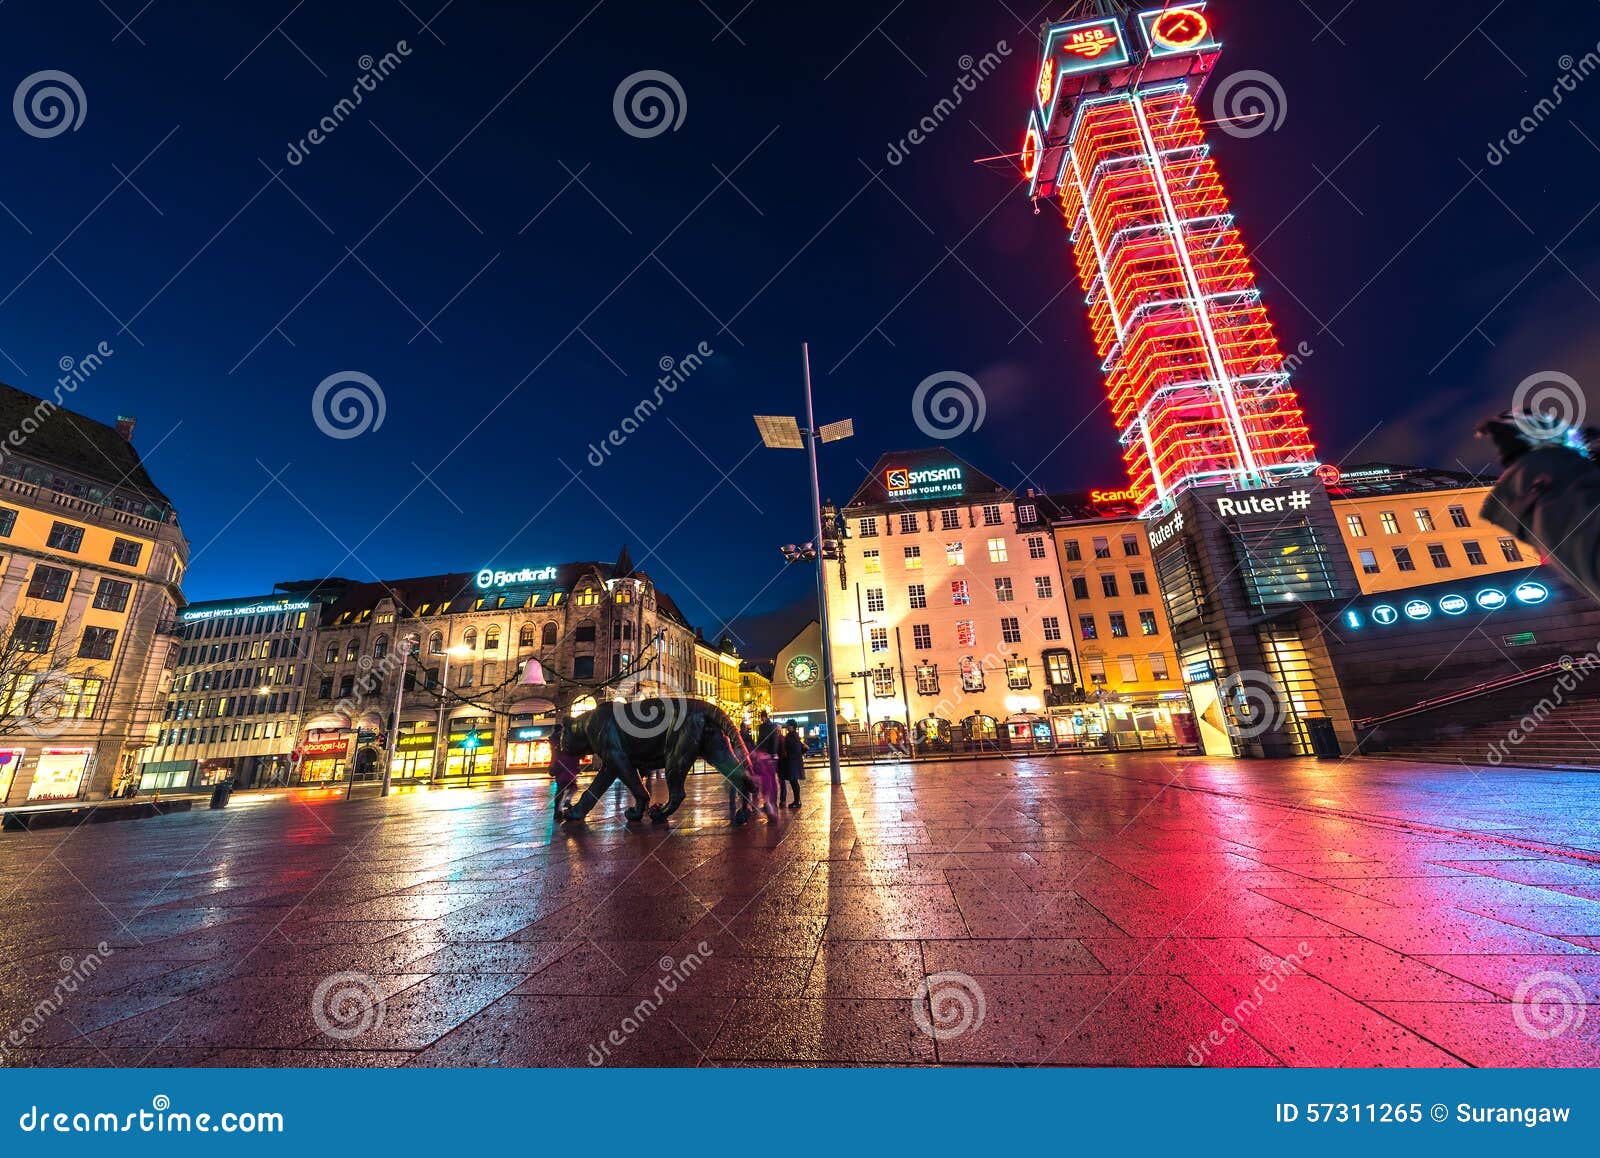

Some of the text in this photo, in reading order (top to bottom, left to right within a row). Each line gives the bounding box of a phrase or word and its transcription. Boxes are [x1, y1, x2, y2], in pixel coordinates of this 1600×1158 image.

[1072, 29, 1104, 44] NSB
[888, 488, 918, 497] DESIGN
[1216, 490, 1311, 517] Ruter#
[1149, 510, 1184, 549] Ruter#
[493, 566, 557, 587] Fjordkraft
[183, 602, 310, 620] COMFORT HOTEL XPRESS CENTRAL STATION
